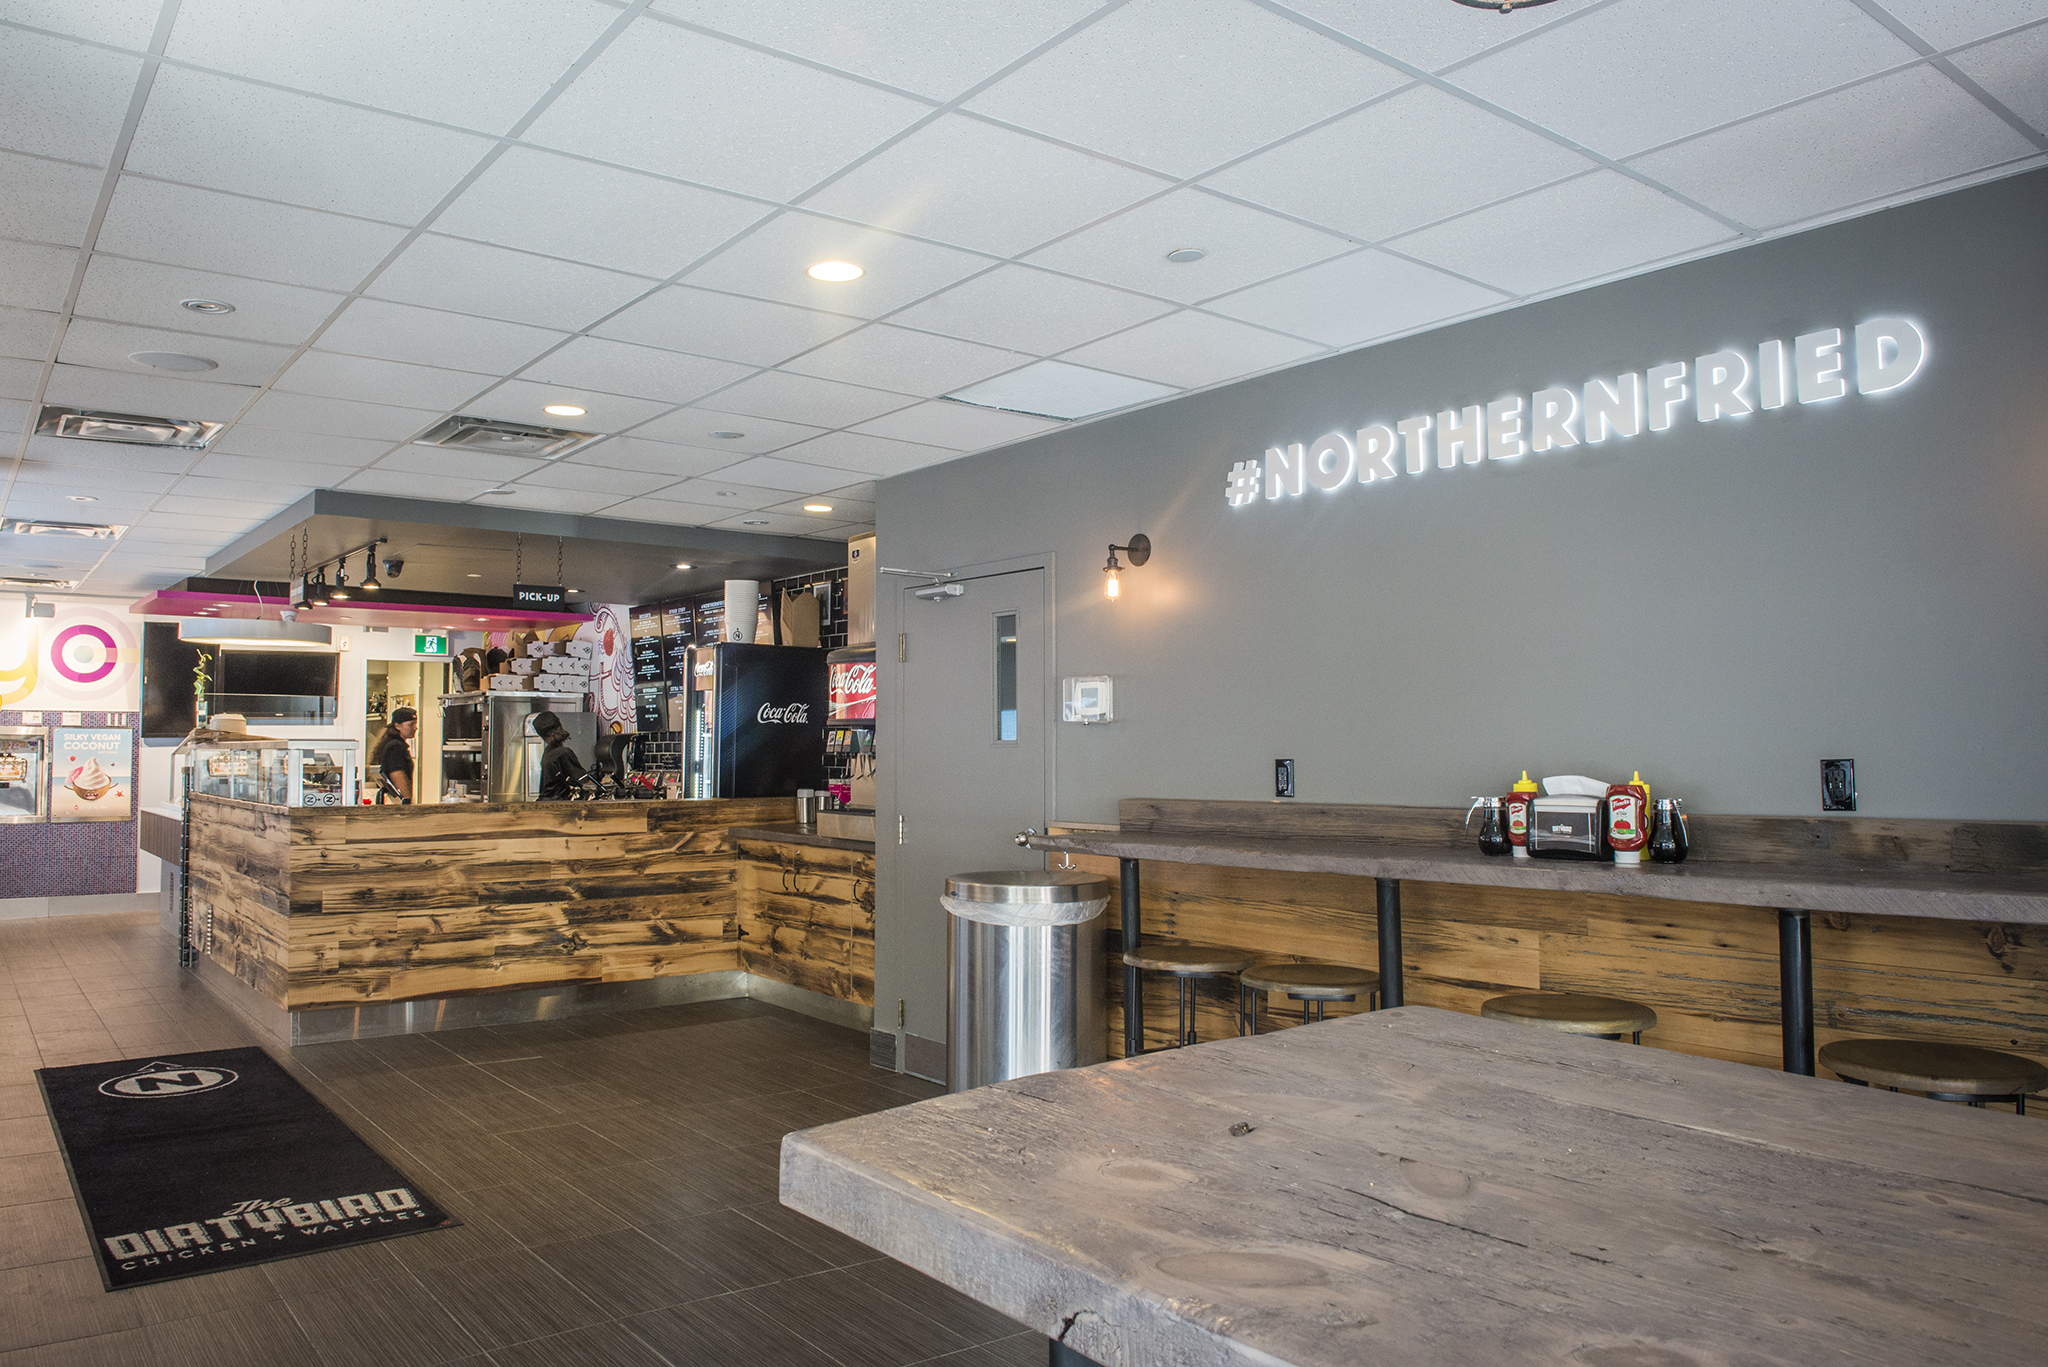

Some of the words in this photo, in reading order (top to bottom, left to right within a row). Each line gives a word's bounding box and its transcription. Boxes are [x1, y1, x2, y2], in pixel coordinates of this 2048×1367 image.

[1225, 317, 1925, 507] #NORTHERNFRIED
[518, 591, 560, 602] PICK-UP
[757, 702, 810, 724] Coca-Cola
[63, 733, 89, 741] SILKY
[90, 733, 121, 741] VEGAN
[63, 741, 121, 750] COCONUT
[222, 1199, 294, 1217] The
[103, 1188, 420, 1260] DIRTYBIRD
[121, 1238, 258, 1271] CHICKEN
[300, 1210, 425, 1236] WAFFLES
